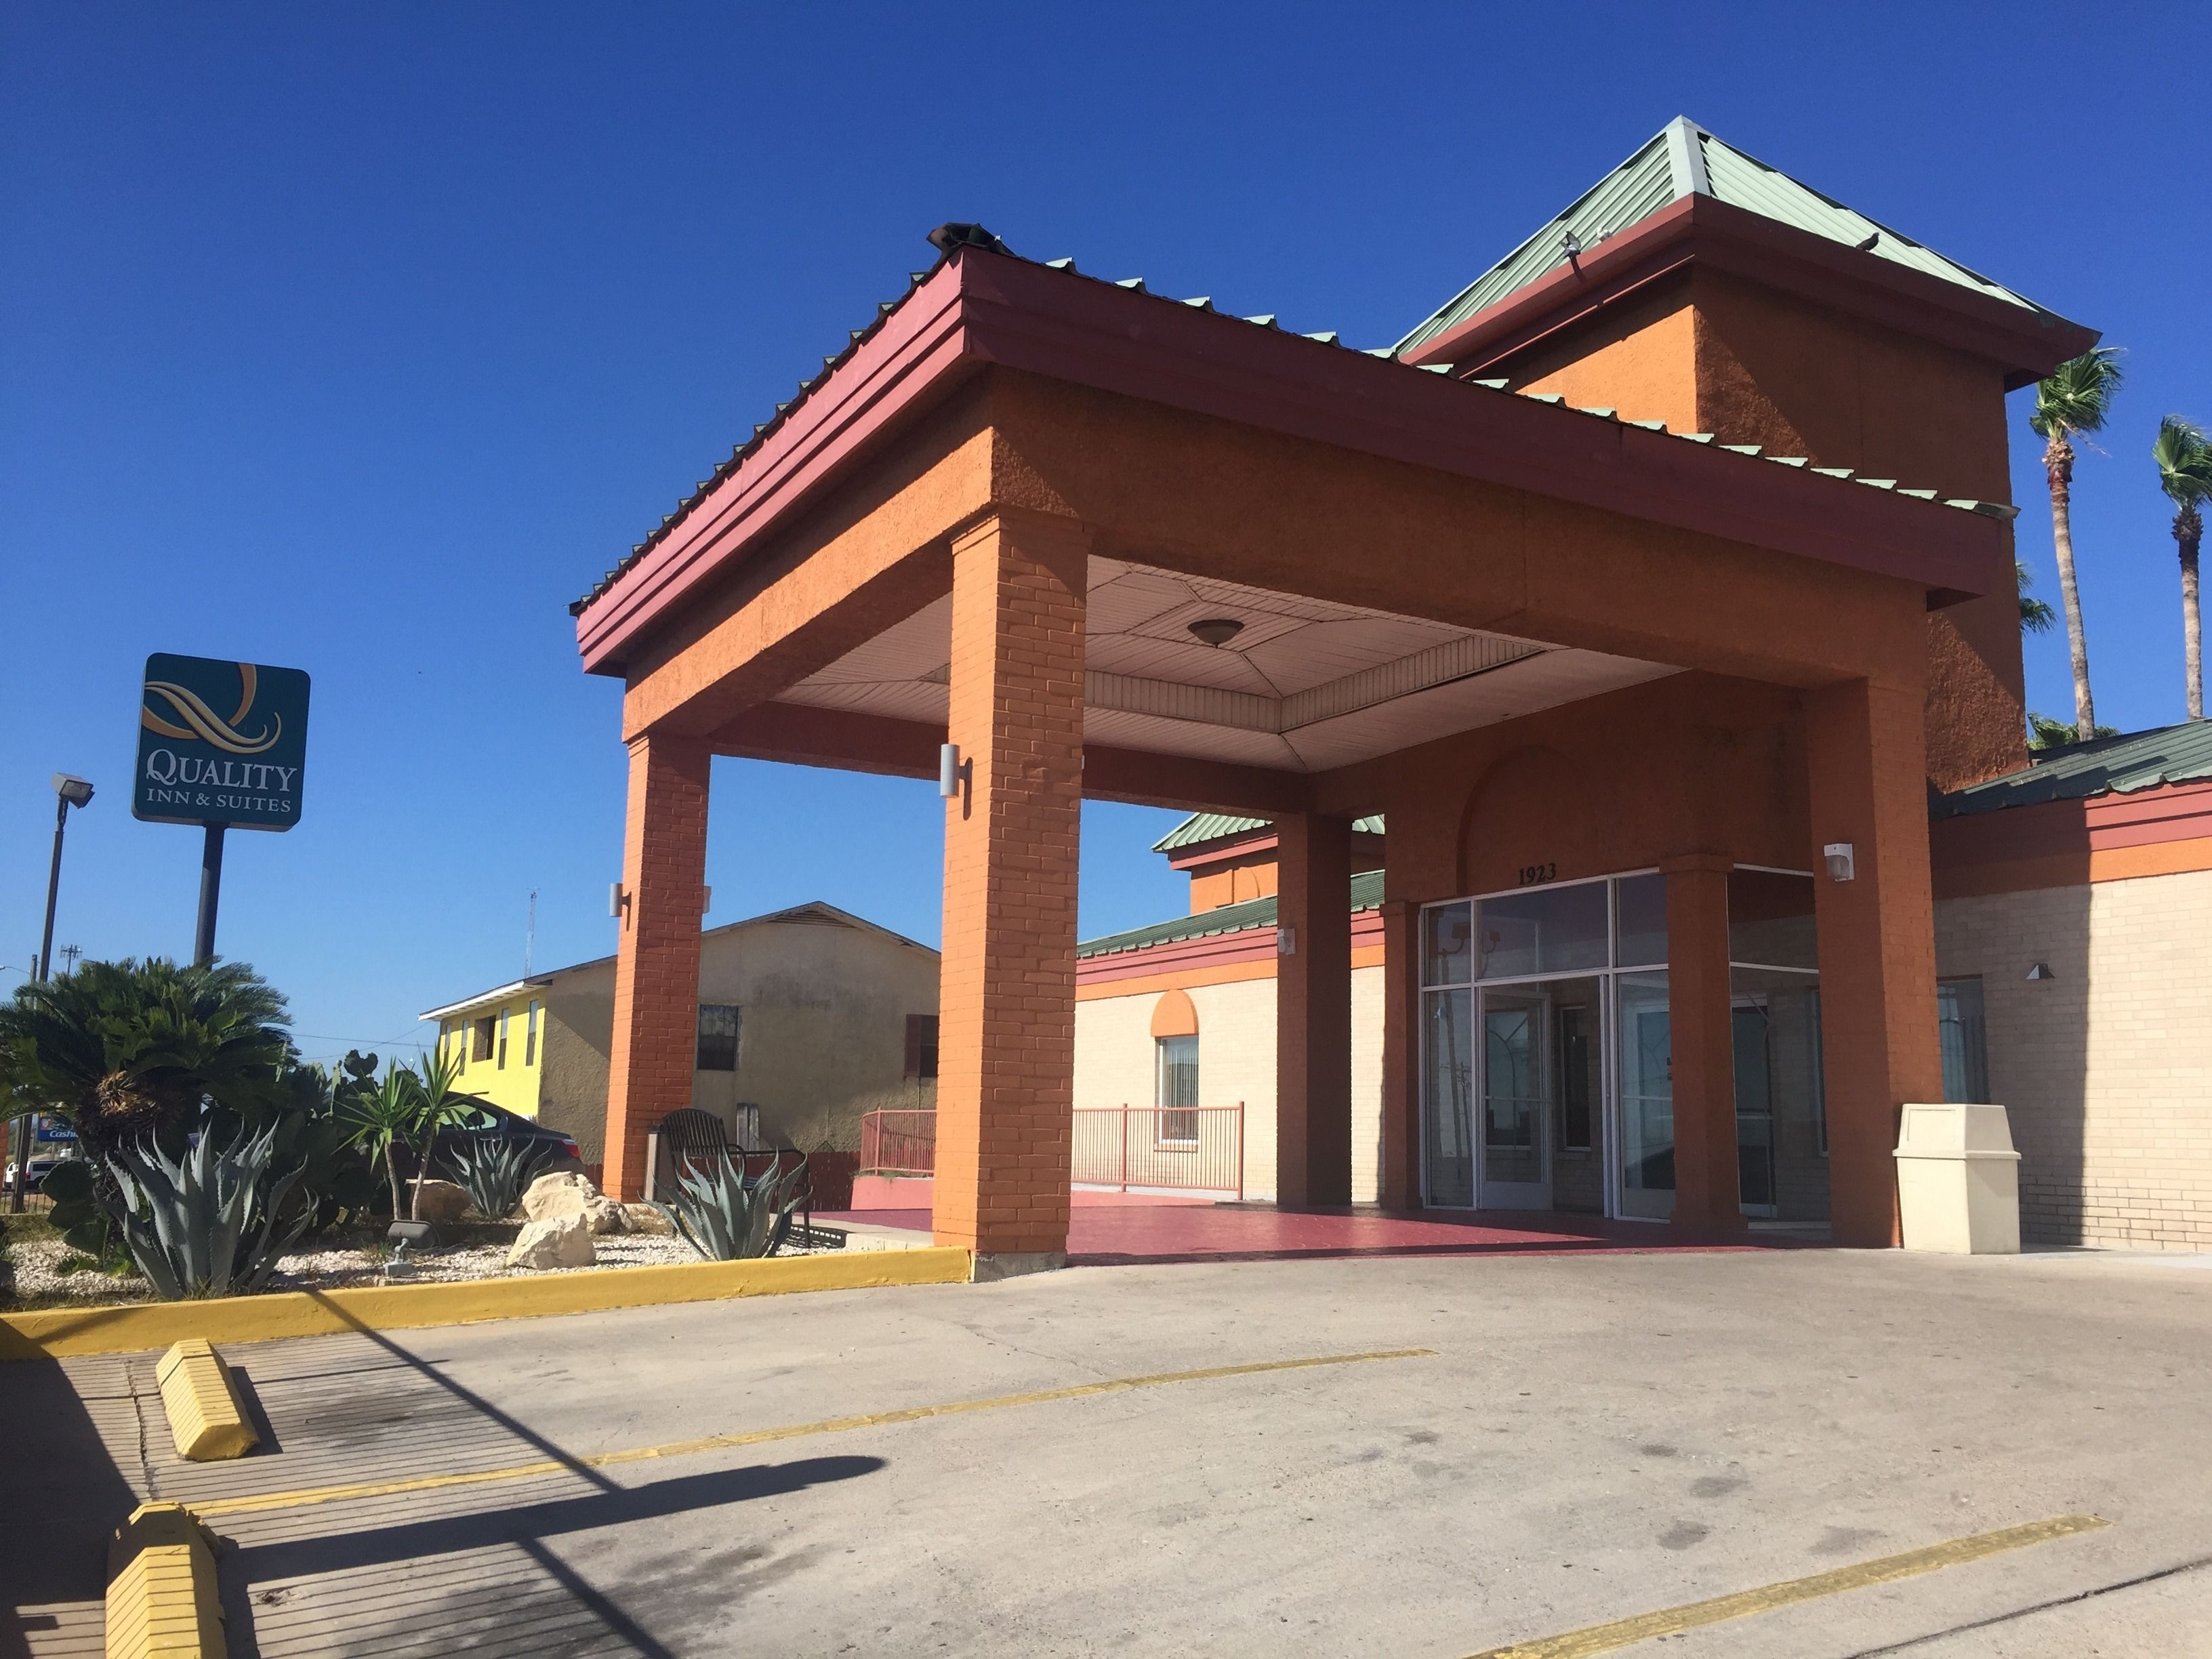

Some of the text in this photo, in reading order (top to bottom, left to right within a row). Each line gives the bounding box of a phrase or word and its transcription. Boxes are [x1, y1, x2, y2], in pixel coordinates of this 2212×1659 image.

[146, 749, 297, 792] QUALITY
[146, 788, 291, 813] INN & SUITES
[1519, 863, 1557, 885] 1923
